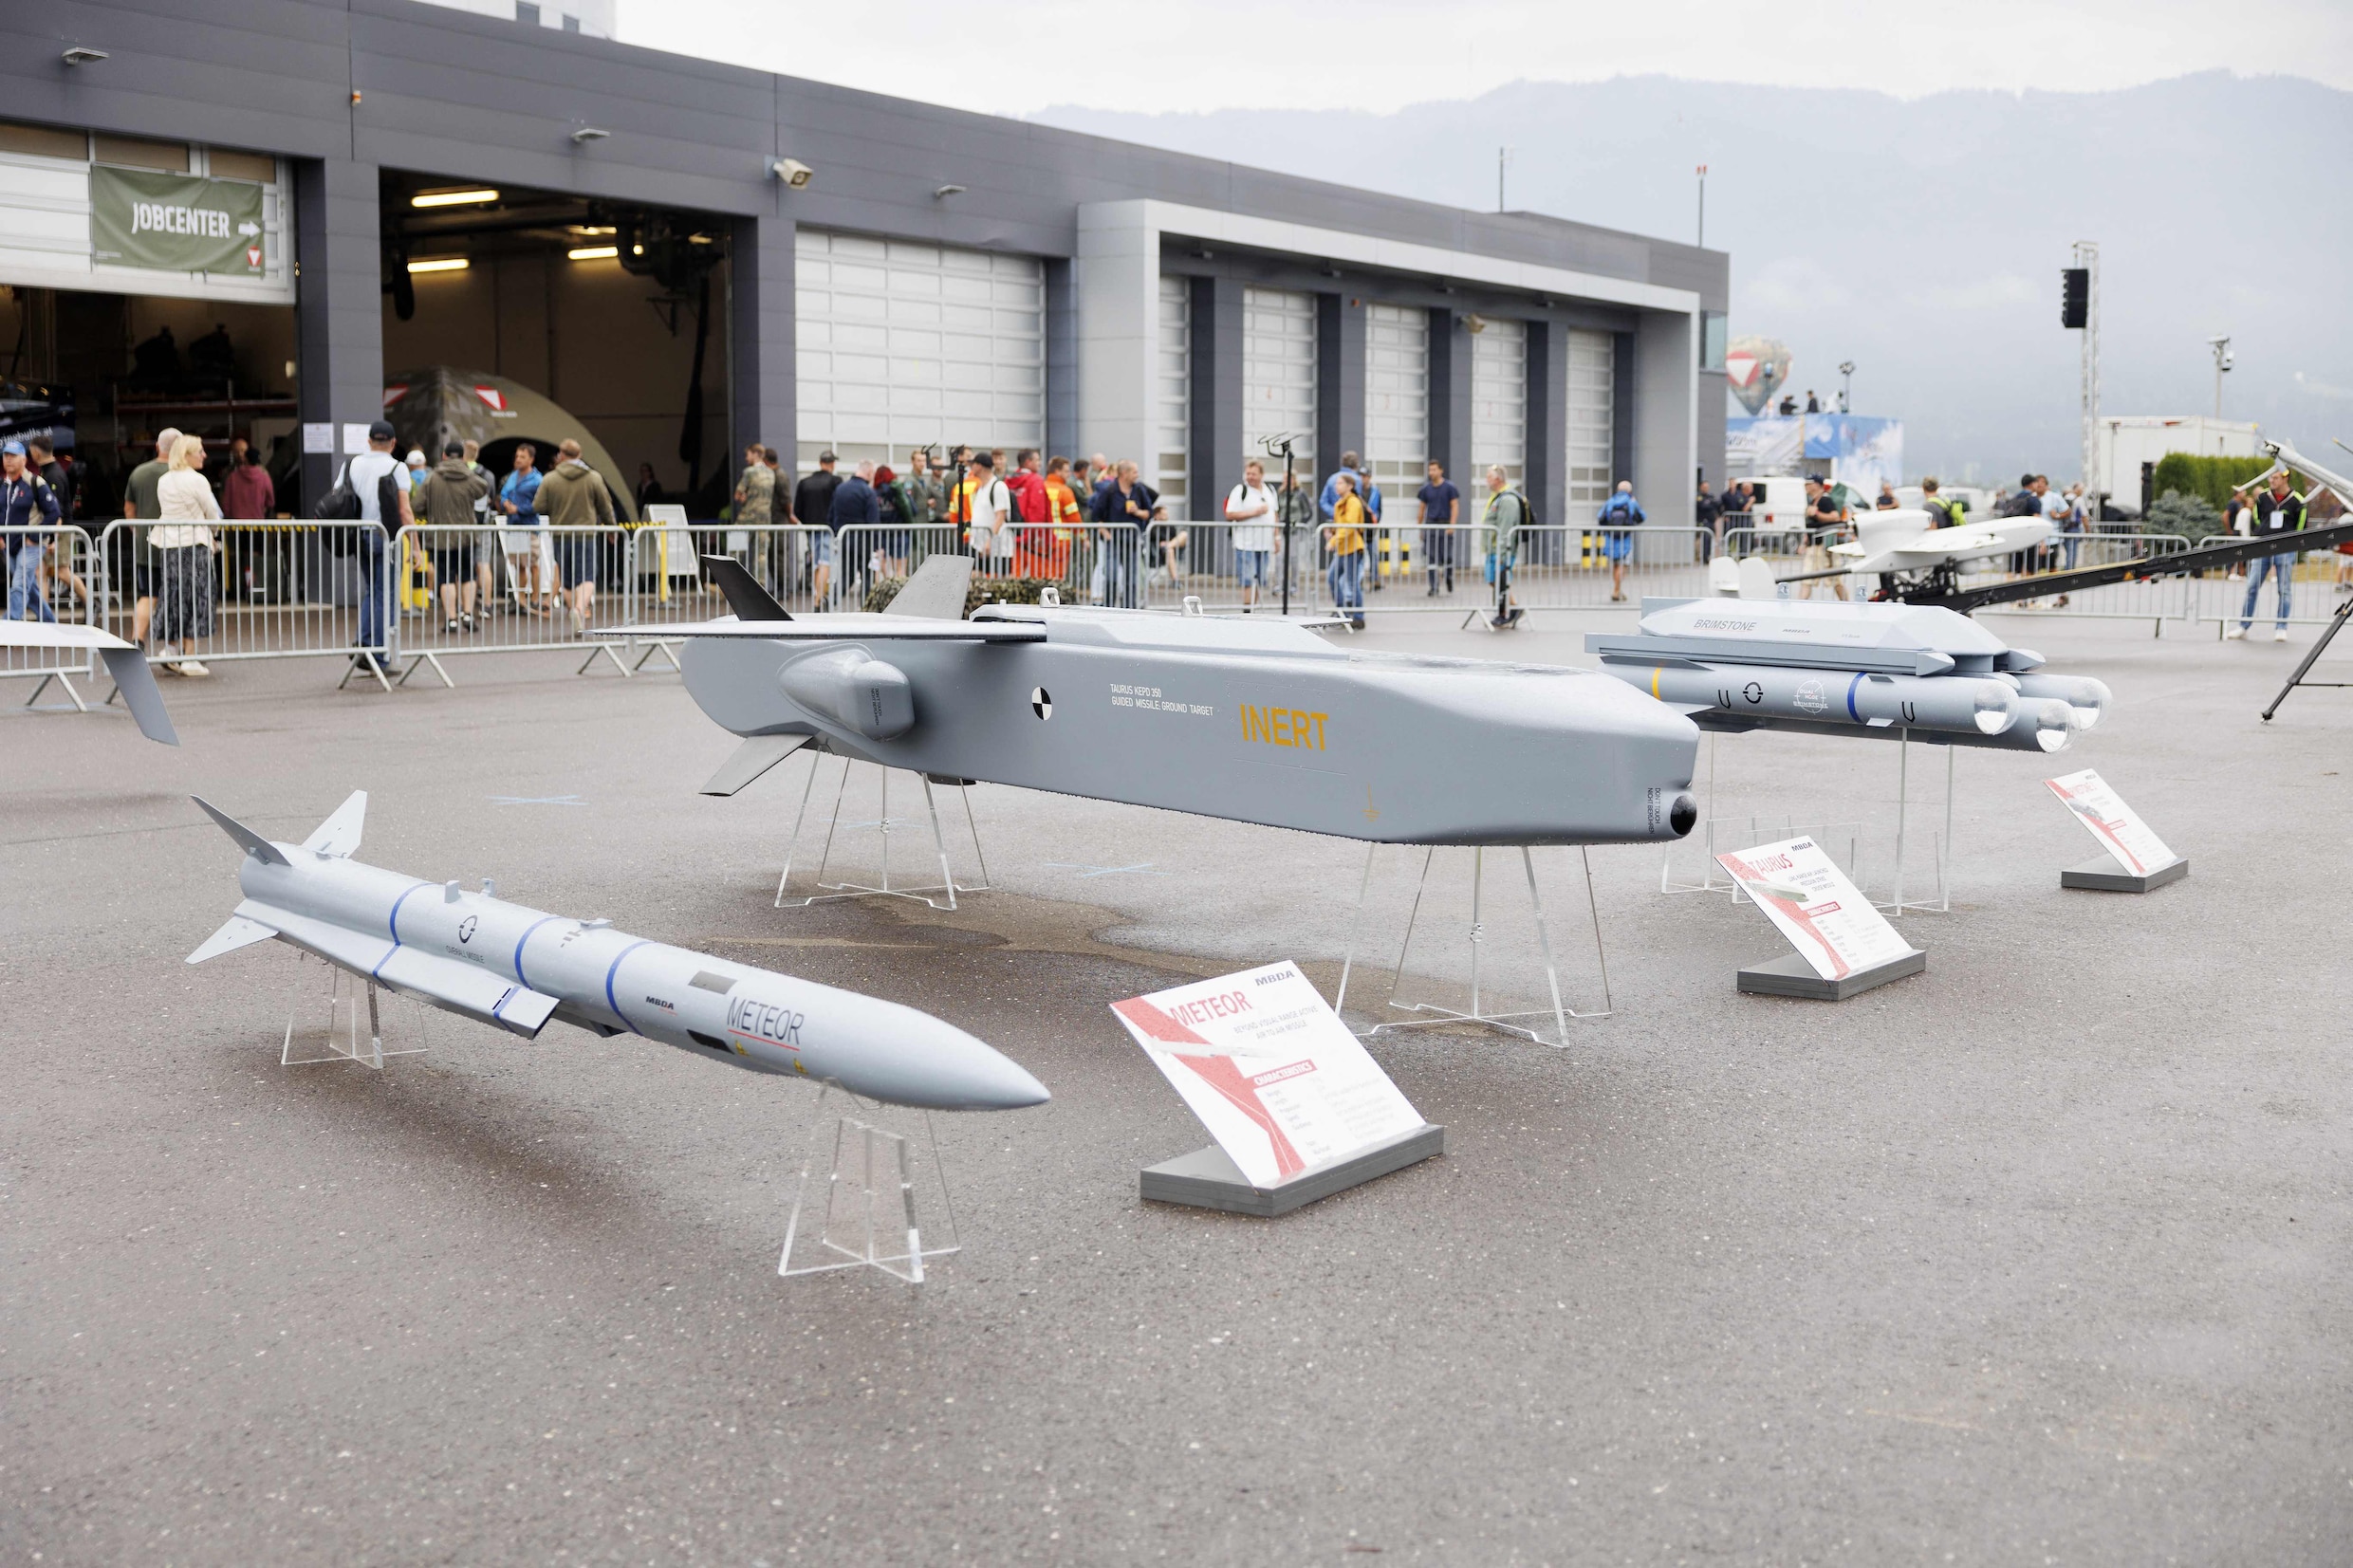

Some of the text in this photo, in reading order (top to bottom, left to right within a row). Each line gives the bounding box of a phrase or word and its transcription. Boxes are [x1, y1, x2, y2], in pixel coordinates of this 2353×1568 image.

[132, 201, 230, 238] JOBCENTER
[1694, 618, 1757, 631] BRIMSTONE
[1110, 683, 1162, 698] TAURUS KEPD 350
[1111, 695, 1134, 707] GUIDED
[1161, 701, 1187, 713] GROUND
[1189, 704, 1214, 716] TARGET
[1239, 703, 1328, 751] INERT
[1791, 841, 1813, 852] MBDA
[1748, 853, 1793, 874] TAURUS
[1254, 969, 1295, 987] MBDA
[645, 996, 675, 1010] MBDA
[1169, 990, 1252, 1026] METEOR
[1299, 1005, 1319, 1018] ACTIVE
[727, 996, 805, 1044] METEOR
